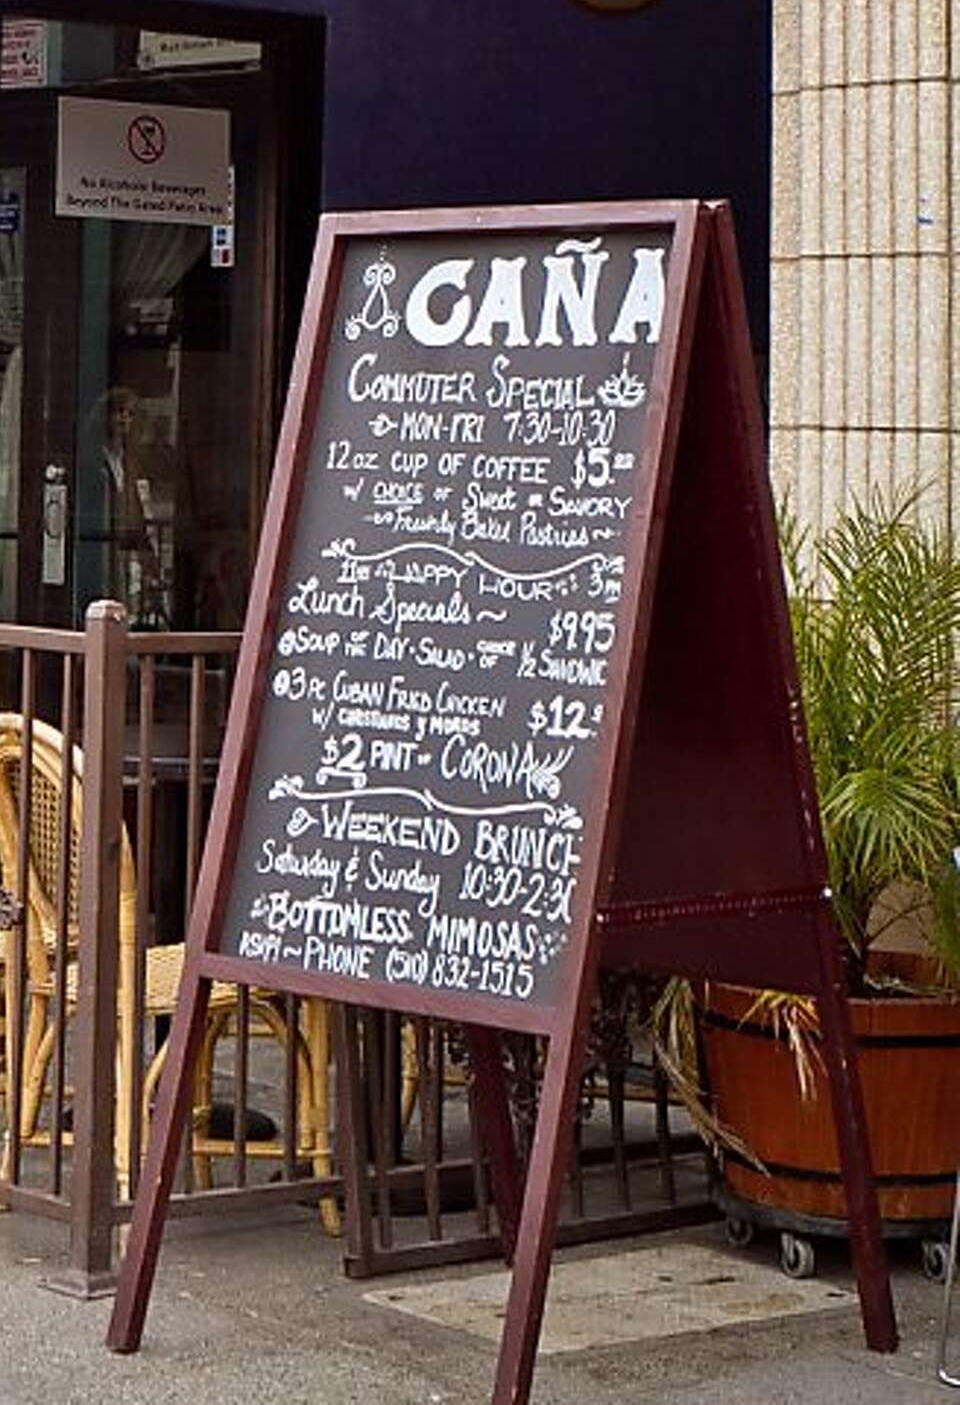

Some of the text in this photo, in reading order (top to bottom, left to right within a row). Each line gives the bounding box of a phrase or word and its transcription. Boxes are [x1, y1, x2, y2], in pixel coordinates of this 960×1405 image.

[111, 196, 130, 208] The
[405, 237, 665, 347] CAÑA
[438, 452, 466, 476] OF
[472, 454, 551, 484] COFFEE
[520, 512, 590, 546] Pastries
[289, 576, 365, 618] Lunch
[369, 582, 470, 635] Specials
[373, 633, 409, 662] DAY
[537, 648, 608, 686] SANDWIC
[321, 732, 368, 773] $2
[321, 800, 461, 856] WEEKEND
[256, 840, 341, 899] Saturday
[365, 850, 440, 917] Sunday
[427, 915, 539, 961] MIMOSAS
[303, 936, 375, 979] PHONE
[431, 953, 534, 999] 832-1515
